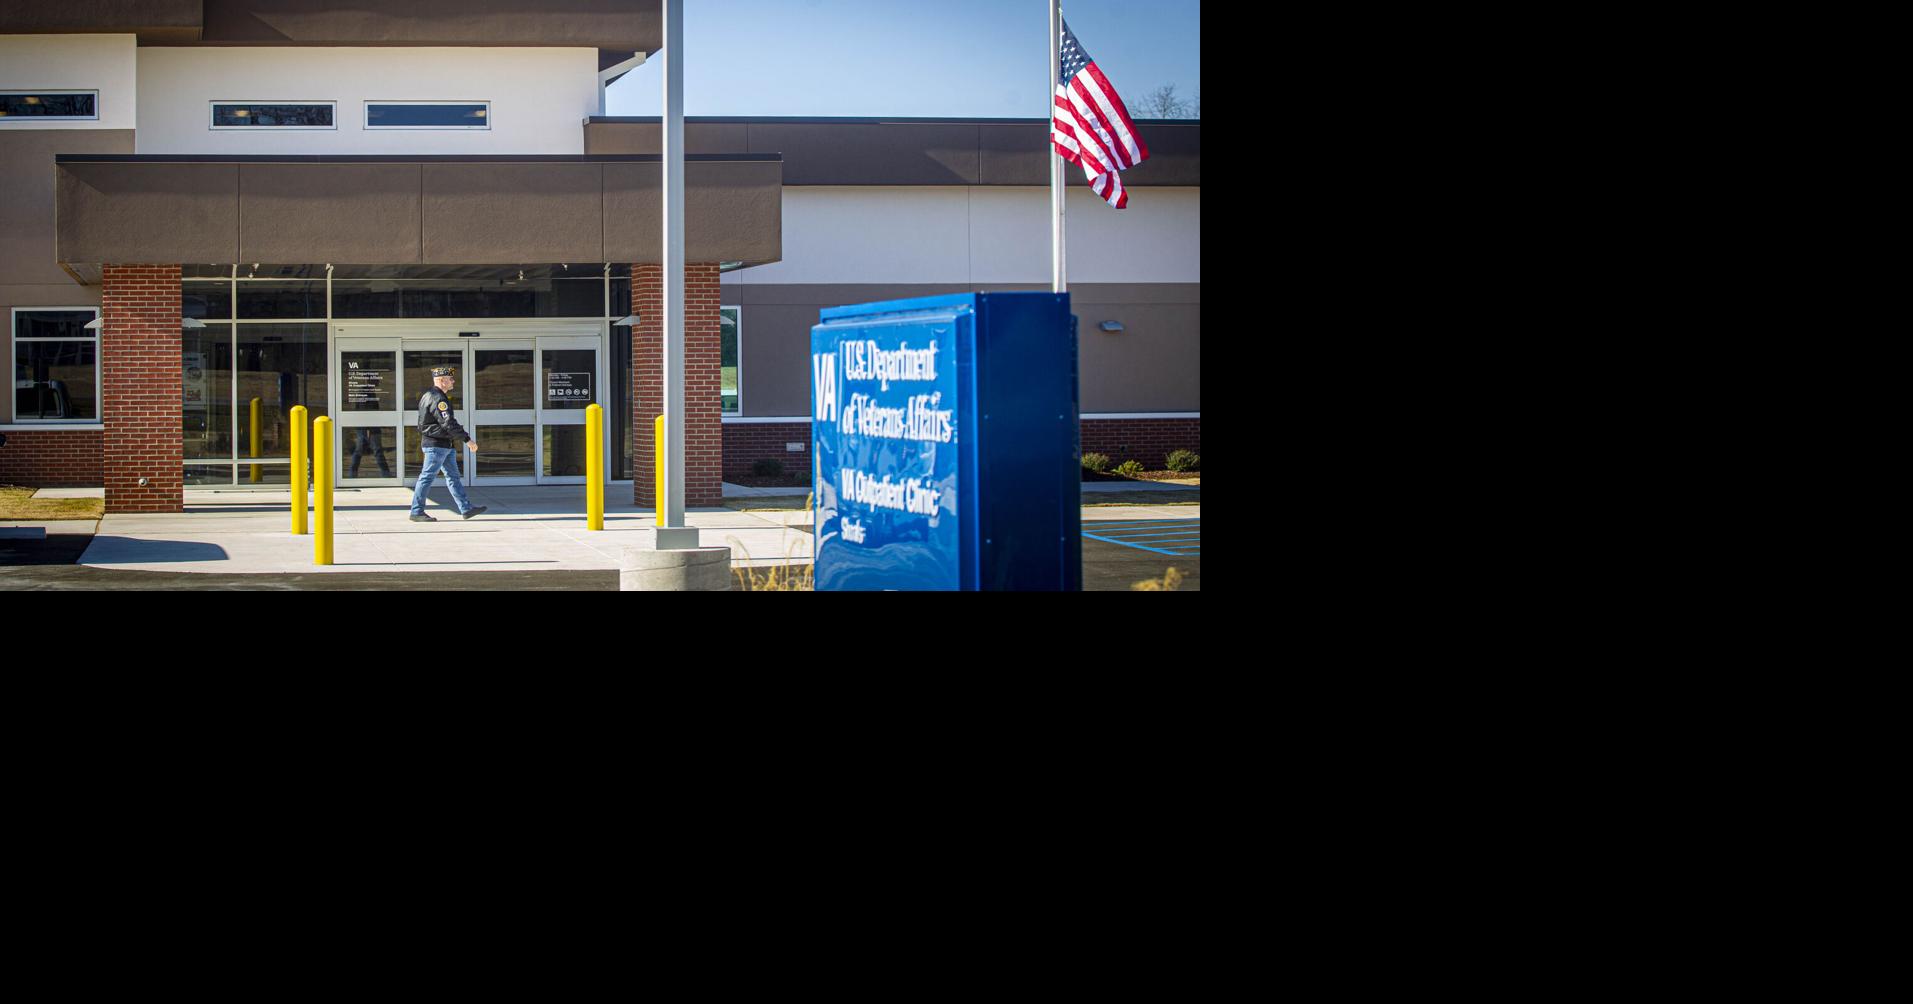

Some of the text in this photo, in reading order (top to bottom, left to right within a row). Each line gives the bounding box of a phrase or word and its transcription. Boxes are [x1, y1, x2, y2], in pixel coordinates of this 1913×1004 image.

[348, 361, 359, 369] VA
[813, 353, 836, 422] VA
[845, 339, 938, 392] U.S. Department
[842, 391, 953, 442] of Veterans Affairs
[842, 468, 940, 517] VA Outpatient Clinic
